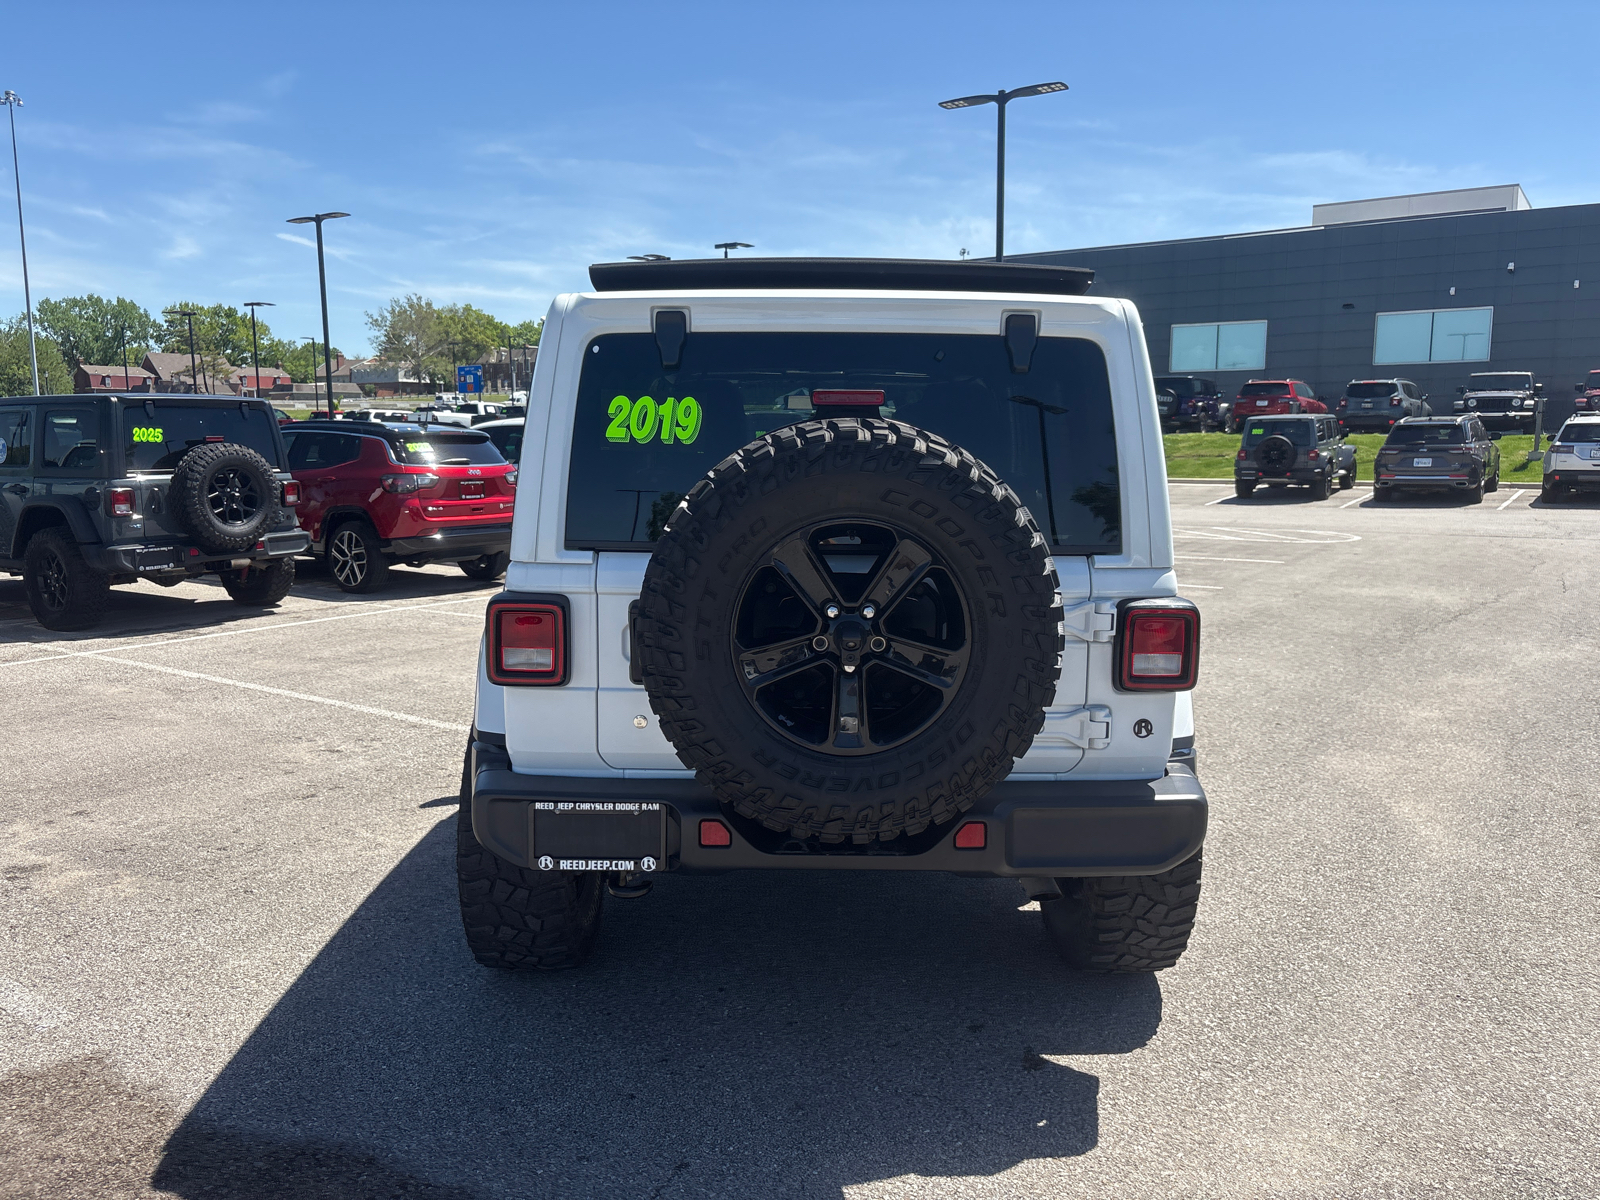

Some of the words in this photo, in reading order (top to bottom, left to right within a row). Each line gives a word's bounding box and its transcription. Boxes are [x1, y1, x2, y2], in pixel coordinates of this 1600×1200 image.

[133, 427, 163, 442] 2025
[605, 395, 702, 444] 2019
[717, 516, 767, 575] PRO
[879, 488, 1007, 618] COOPER
[693, 577, 719, 662] STT
[751, 717, 976, 792] DISCOVERER
[535, 802, 554, 810] REED
[557, 802, 574, 810] JEEP
[576, 802, 613, 811] CHRYSLER
[615, 803, 640, 811] DODGE
[641, 803, 660, 811] RAM
[559, 860, 635, 871] REEDJEEP.COM
